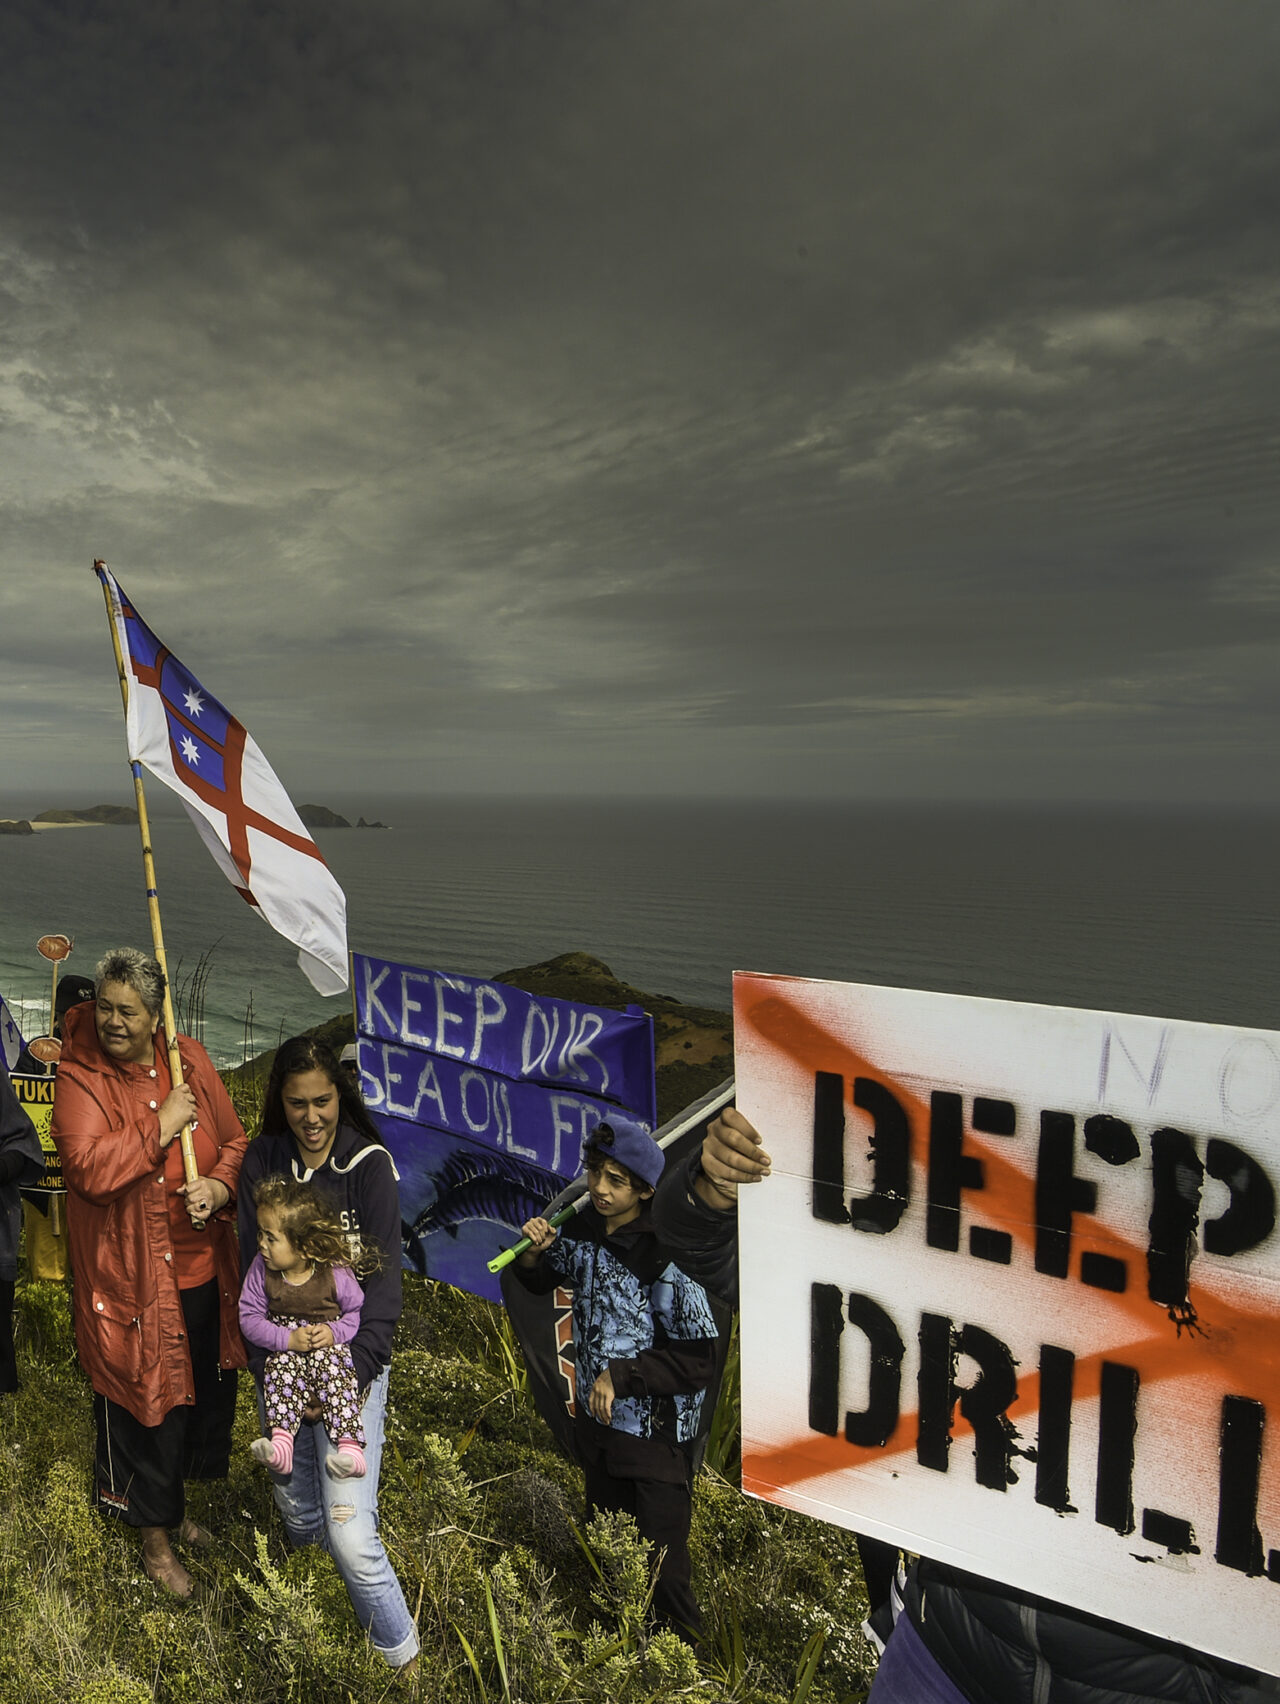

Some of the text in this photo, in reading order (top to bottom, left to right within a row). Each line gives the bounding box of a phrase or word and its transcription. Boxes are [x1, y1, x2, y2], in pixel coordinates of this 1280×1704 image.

[359, 958, 507, 1061] KEEP
[357, 1037, 449, 1126] SEA
[459, 1070, 537, 1161] OIL
[43, 1156, 62, 1167] ANG
[812, 1070, 1275, 1306] DEEP
[808, 1282, 1280, 1578] DRILL
